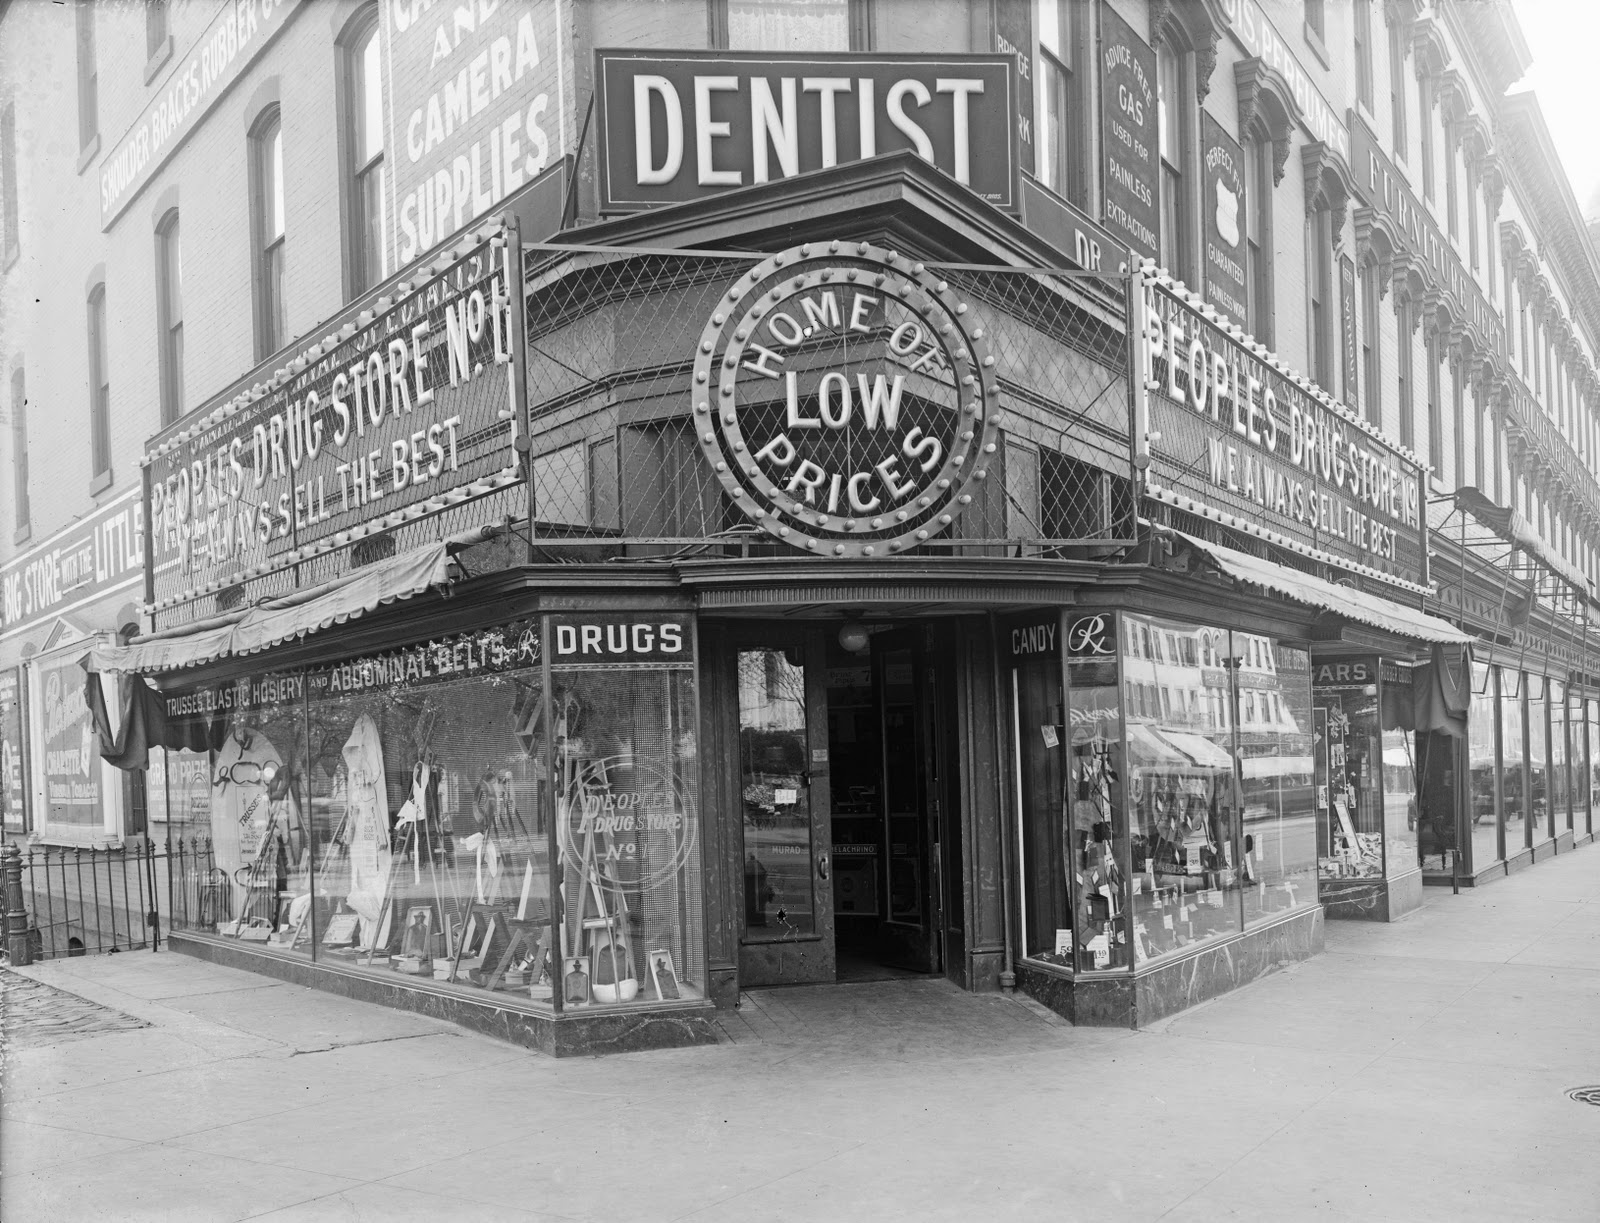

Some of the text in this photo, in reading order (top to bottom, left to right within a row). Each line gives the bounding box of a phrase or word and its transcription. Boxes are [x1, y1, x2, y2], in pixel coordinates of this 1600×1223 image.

[430, 0, 499, 70] AND
[407, 11, 540, 162] CAMERA
[1105, 45, 1153, 108] ADVICE FREE
[1119, 84, 1144, 126] GAS
[1262, 20, 1347, 158] PERFUMES
[633, 74, 985, 186] DENTIST
[1112, 121, 1149, 162] USED FOR
[102, 124, 149, 212] SHOULDER
[400, 93, 549, 264] SUPPLIES
[1109, 157, 1153, 207] PAINLESS
[1206, 146, 1245, 200] PERFECT FIT
[1369, 148, 1467, 311] FURNITURE
[1207, 242, 1245, 286] GUARANTEED
[1208, 282, 1246, 321] PAINLESS WORK
[742, 291, 948, 380] HOME OF
[153, 437, 243, 536] PEOPLES
[253, 390, 323, 490] DRUG
[332, 320, 435, 448] STORE
[785, 370, 905, 431] LOW
[1146, 304, 1277, 452] PEOPLES
[1289, 404, 1345, 488] DRUG
[1348, 442, 1399, 520] STORE
[206, 500, 272, 567] ALWAYS
[278, 475, 330, 537] SELL
[337, 449, 384, 512] THE
[393, 415, 462, 493] BEST
[753, 426, 942, 513] PRICES
[1208, 438, 1397, 562] WE ALWAYS SELL THE BEST
[4, 571, 22, 625] BIG
[25, 548, 62, 615] STORE
[61, 552, 78, 584] WITH
[78, 545, 93, 576] THE
[95, 501, 143, 584] LITTLE
[556, 623, 682, 655] DRUGS
[1012, 622, 1056, 655] CANDY
[206, 685, 250, 711] ELASTIC
[253, 675, 304, 704] HOSIERY
[309, 676, 328, 688] AND
[331, 651, 431, 692] ABDOMINAL
[238, 793, 263, 827] TRUSSES
[577, 791, 675, 834] PEOPLES
[594, 813, 682, 838] DRUG STORE
[771, 846, 801, 855] MURAD
